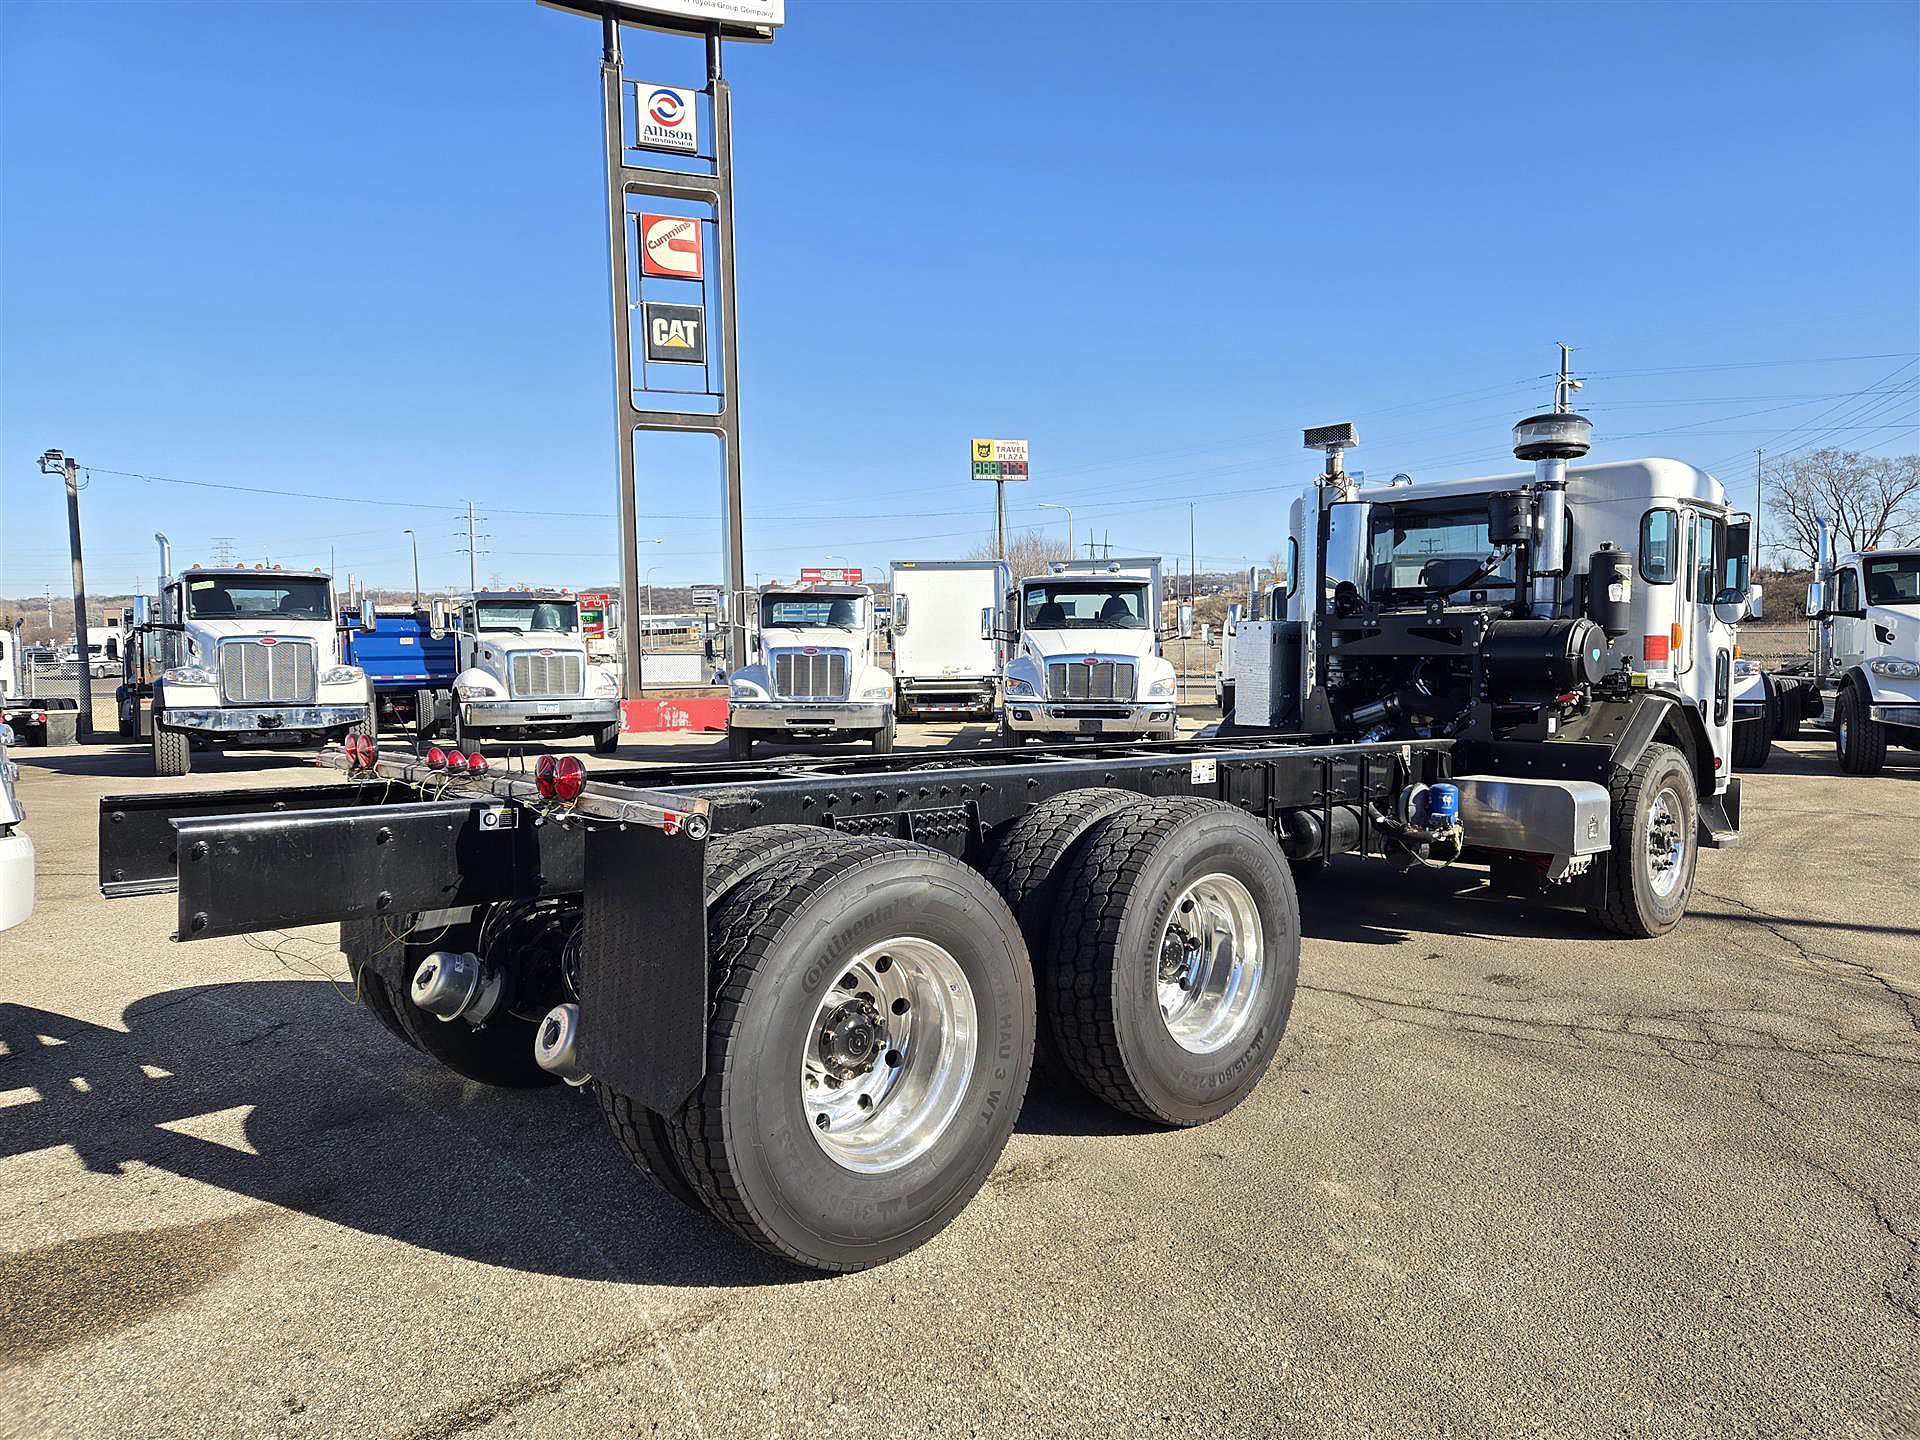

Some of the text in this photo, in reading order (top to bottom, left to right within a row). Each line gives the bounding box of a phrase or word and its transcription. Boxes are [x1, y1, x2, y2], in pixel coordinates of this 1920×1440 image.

[717, 2, 739, 12] Group
[740, 6, 774, 18] Company
[643, 125, 693, 141] Allison
[643, 134, 693, 147] Transmission
[647, 221, 691, 250] Cummins
[652, 318, 698, 348] CAT
[801, 897, 901, 993] Continental
[981, 1089, 1002, 1125] WT
